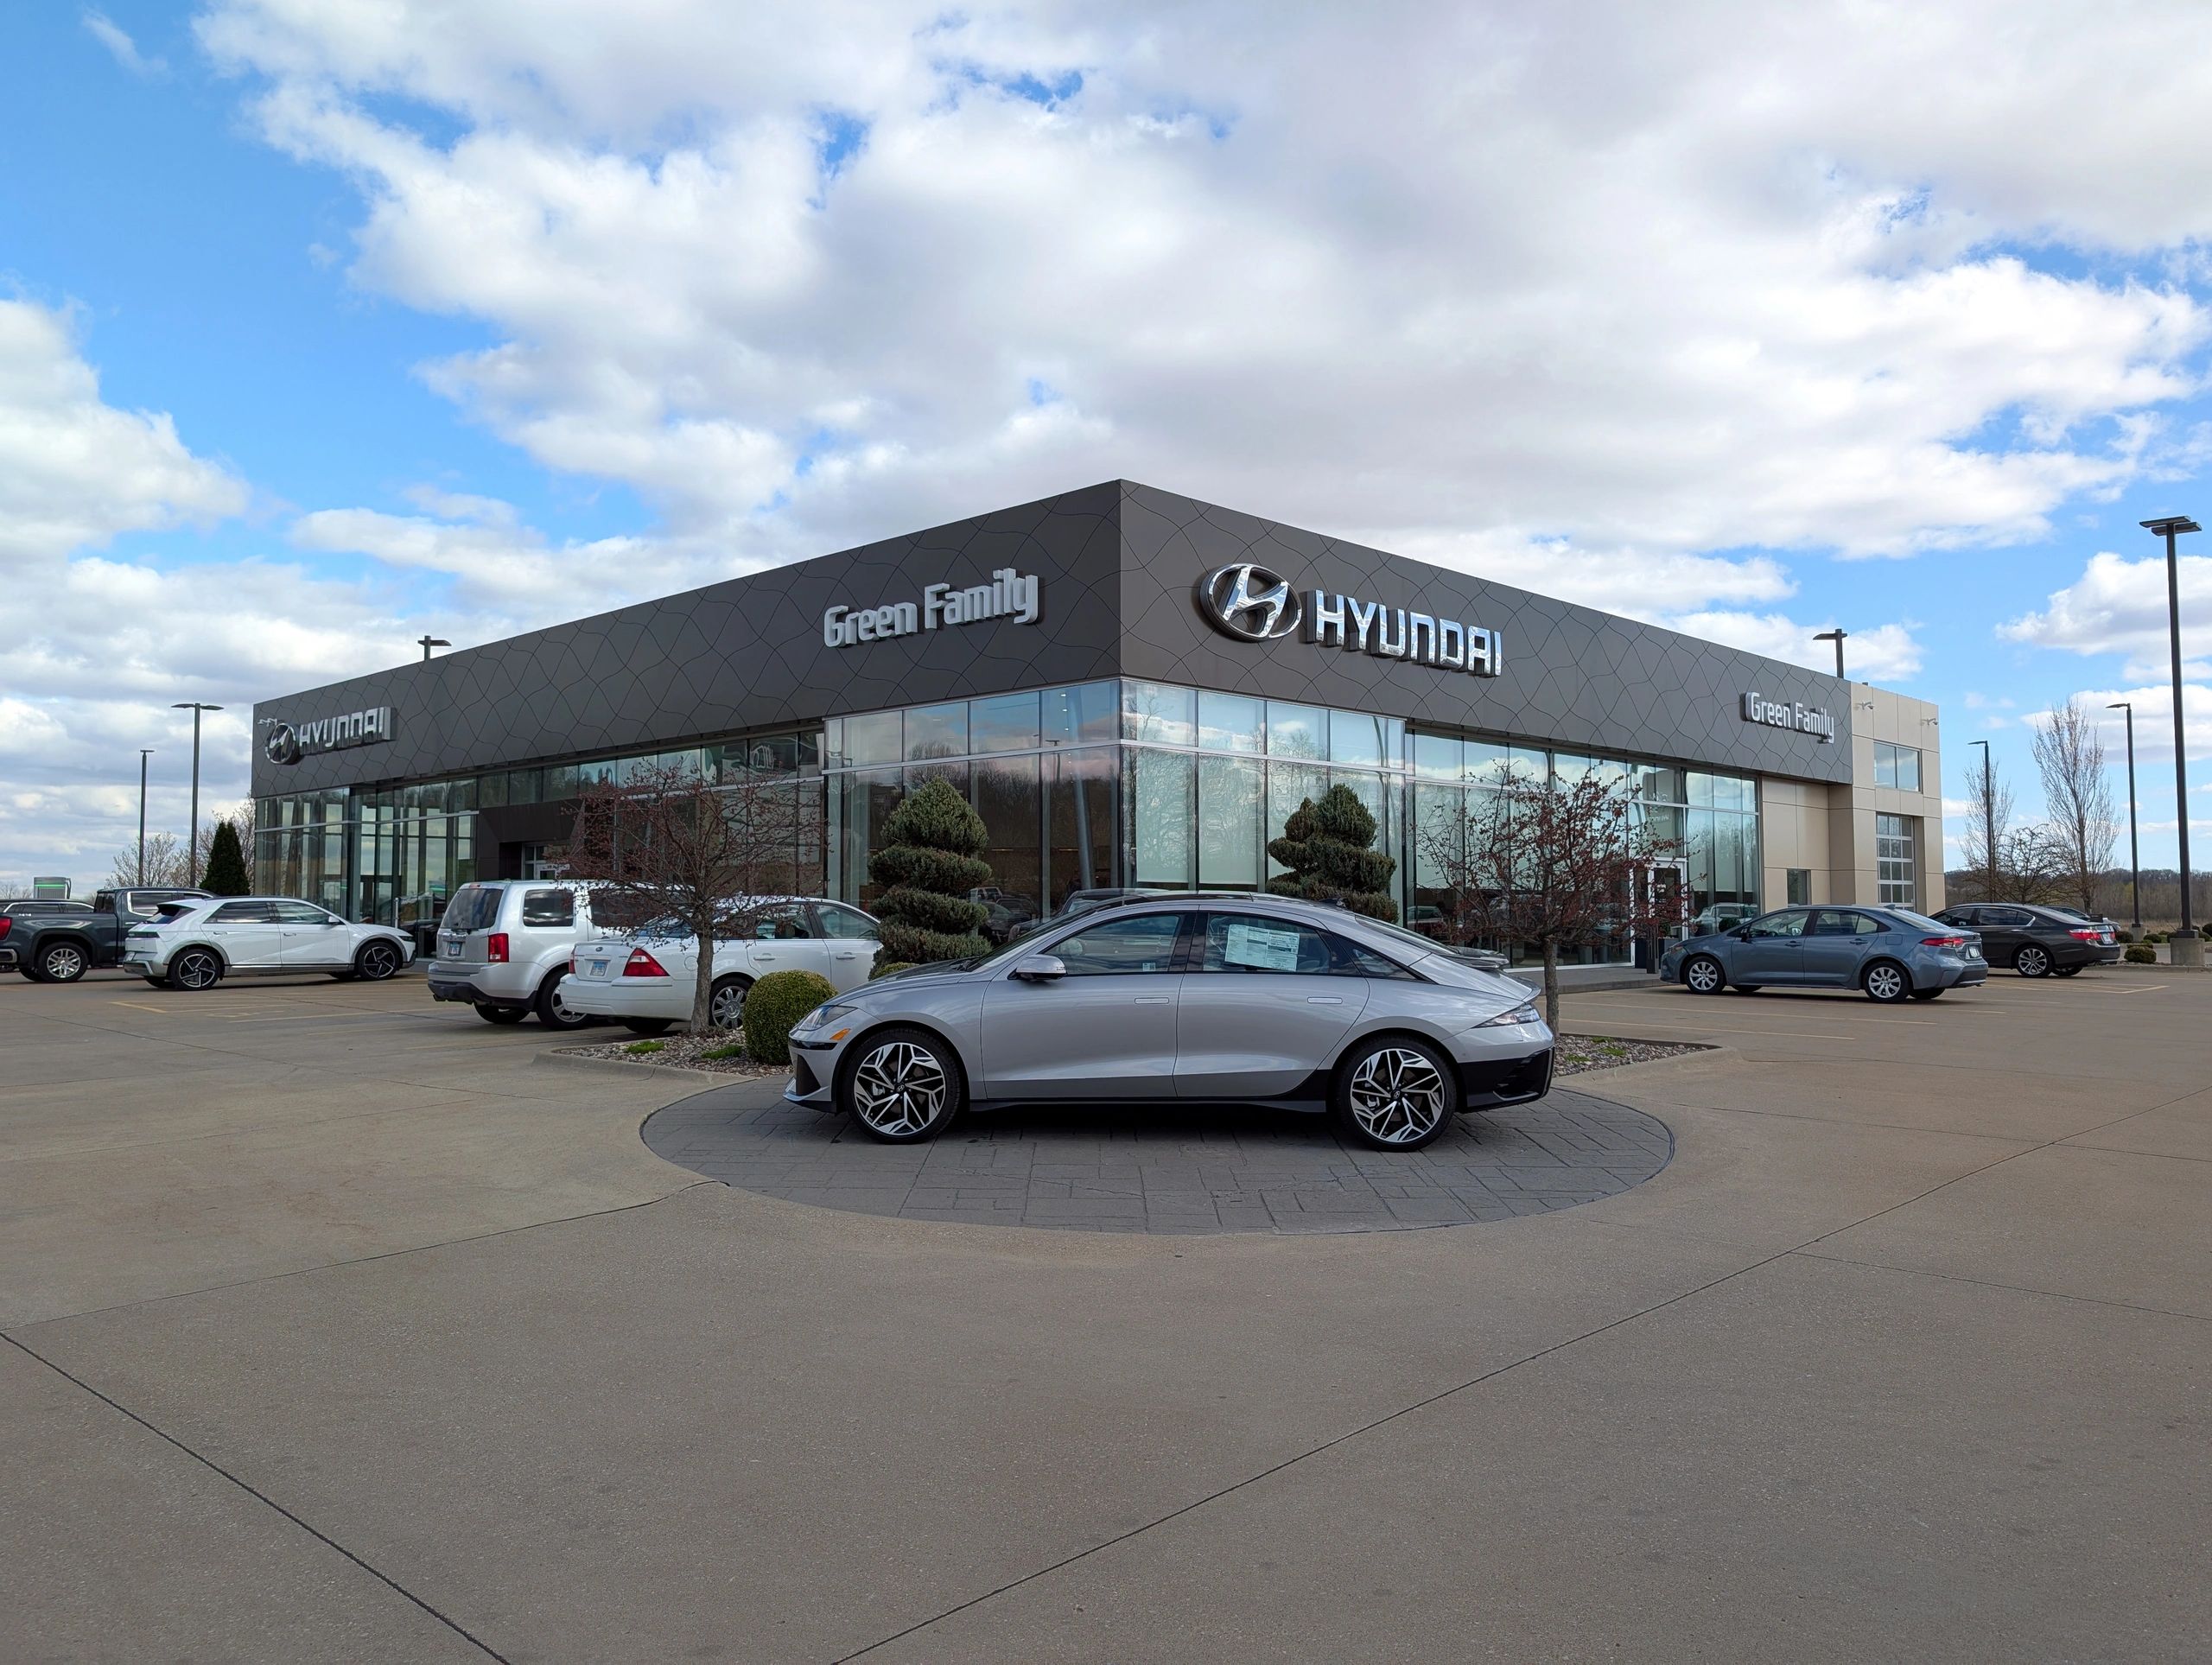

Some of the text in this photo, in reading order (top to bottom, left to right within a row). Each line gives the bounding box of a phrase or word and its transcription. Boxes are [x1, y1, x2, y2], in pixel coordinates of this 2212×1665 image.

[824, 568, 1039, 647] Green Family
[1312, 589, 1502, 677] HYUNDAI
[299, 707, 390, 754] HYUNDAI
[1748, 692, 1834, 744] Green Family
